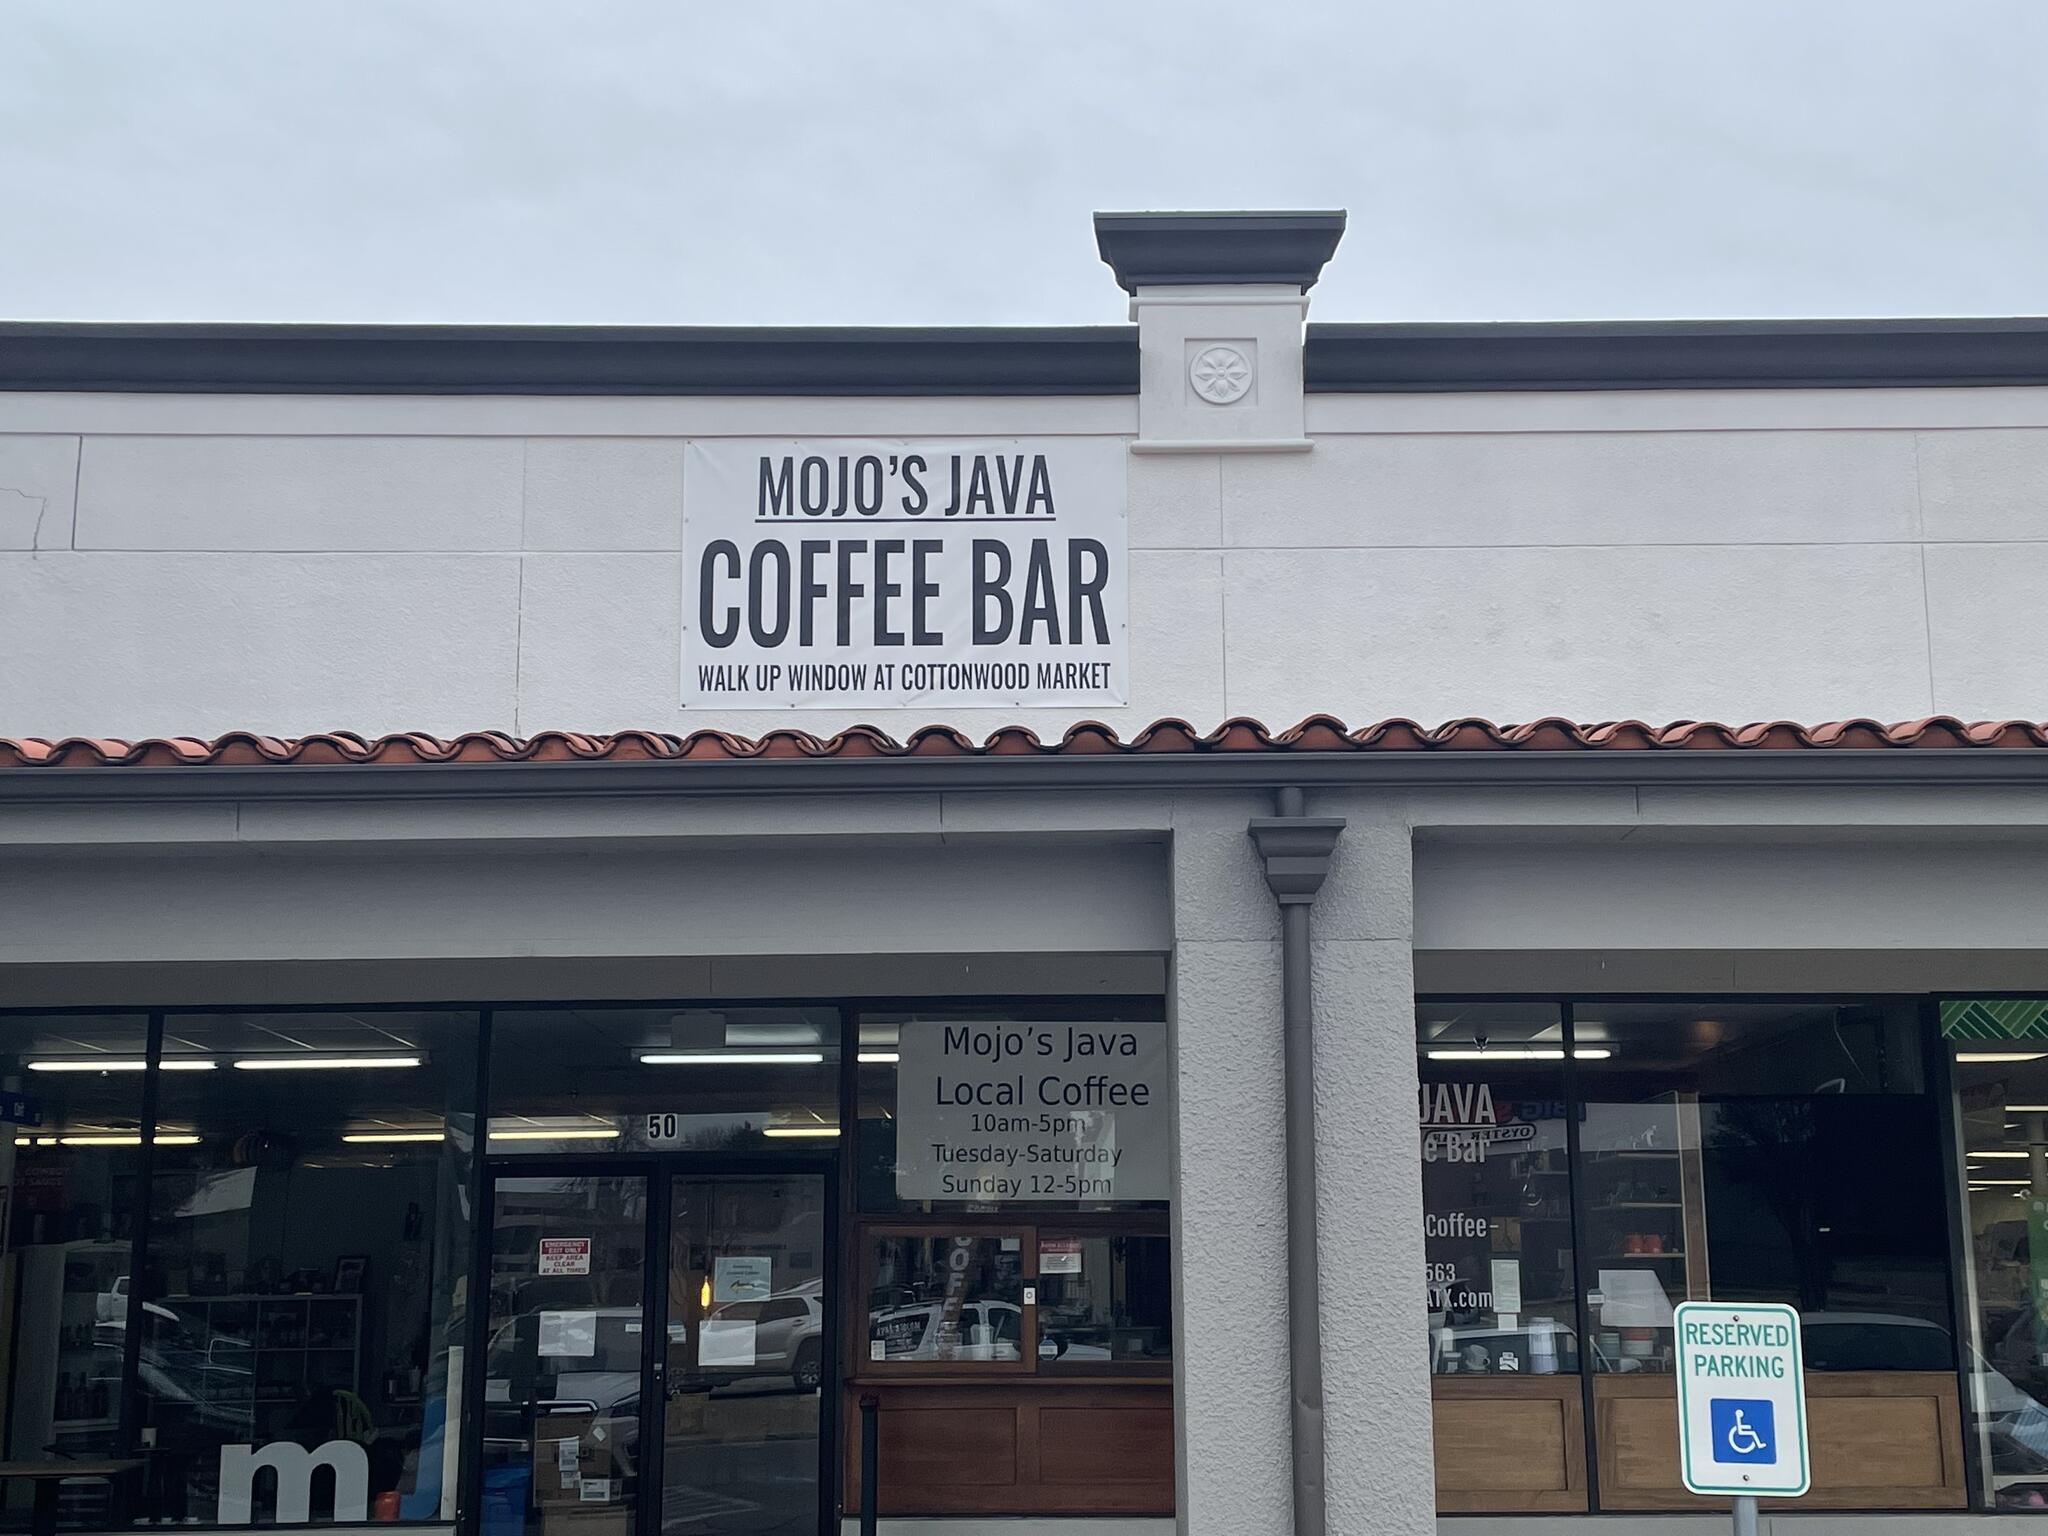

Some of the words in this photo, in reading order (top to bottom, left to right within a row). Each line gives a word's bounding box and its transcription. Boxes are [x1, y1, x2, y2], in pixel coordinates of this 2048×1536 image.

[758, 455, 928, 517] MOJO'S
[944, 454, 1056, 516] JAVA
[699, 538, 944, 649] COFFEE
[971, 537, 1112, 646] BAR
[698, 664, 750, 692] WALK
[755, 664, 782, 692] UP
[787, 664, 868, 691] WINDOW
[873, 664, 896, 691] AT
[901, 663, 1030, 690] COTTONWOOD
[1036, 663, 1111, 690] MARKET
[944, 1026, 1053, 1063] Mojo's
[1063, 1026, 1138, 1062] Java
[936, 1075, 1024, 1106] Local
[1038, 1075, 1150, 1106] Coffee
[1420, 1083, 1497, 1124] JAVA
[648, 1114, 676, 1138] 50
[971, 1114, 1086, 1138] 10am-5pm
[932, 1144, 1123, 1169] Tuesday-Saturday
[1447, 1134, 1490, 1163] Bar
[942, 1175, 1022, 1197] Sunday
[1031, 1175, 1112, 1196] 12-5pm
[1426, 1263, 1456, 1282] 563
[1685, 1322, 1789, 1347] RESERVED
[1694, 1354, 1784, 1379] PARKING
[218, 1440, 368, 1524] m
